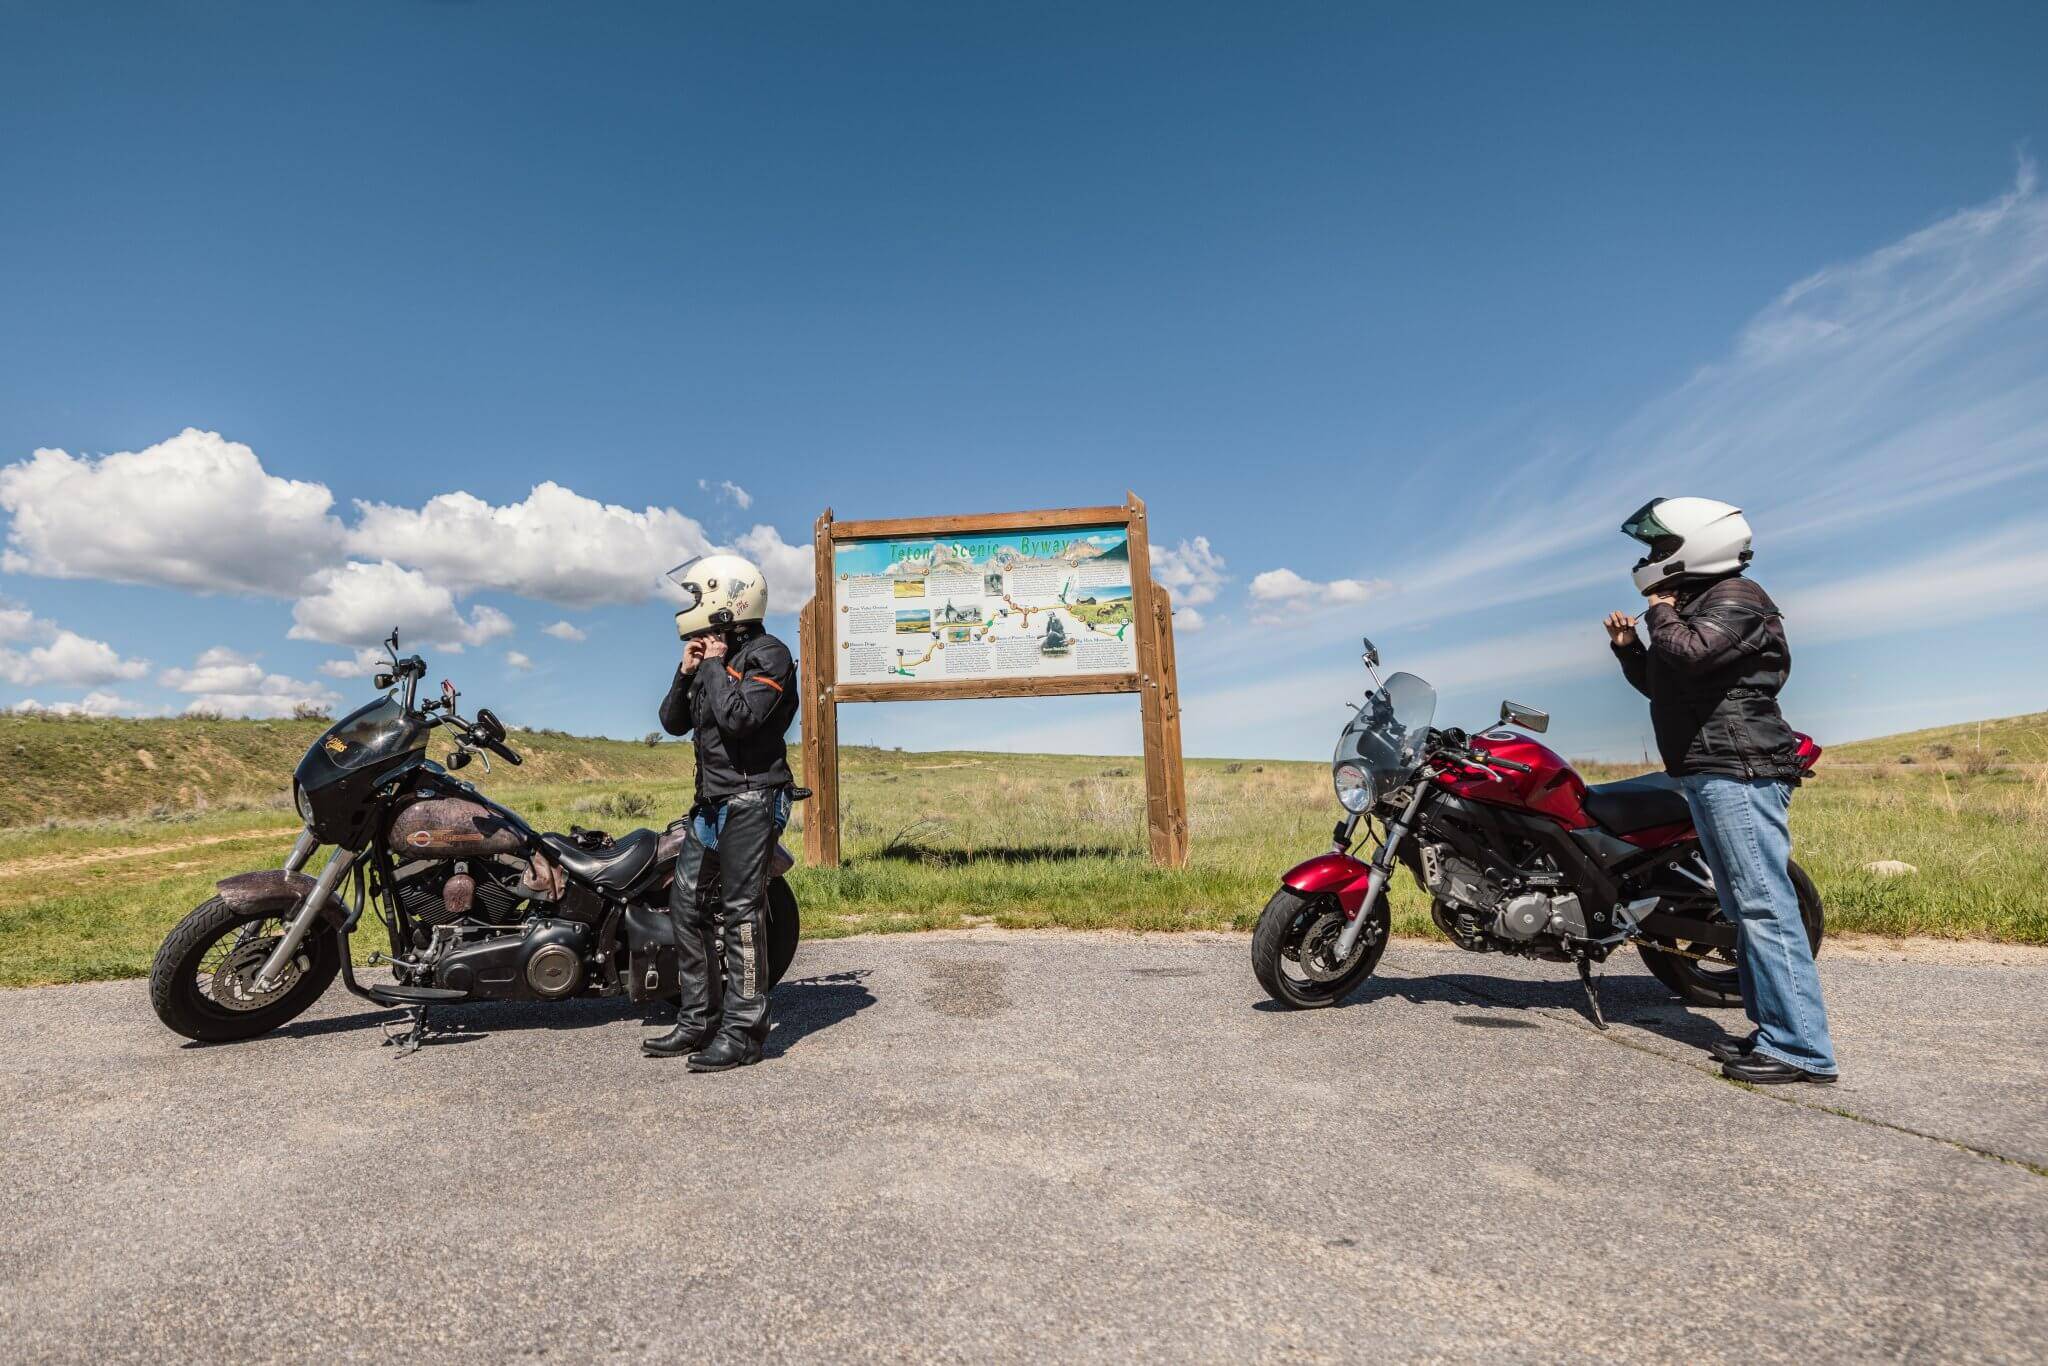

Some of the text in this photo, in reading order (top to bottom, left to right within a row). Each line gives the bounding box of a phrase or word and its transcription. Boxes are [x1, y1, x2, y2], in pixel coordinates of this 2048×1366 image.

[889, 536, 1071, 560] Teton Scenic Byway
